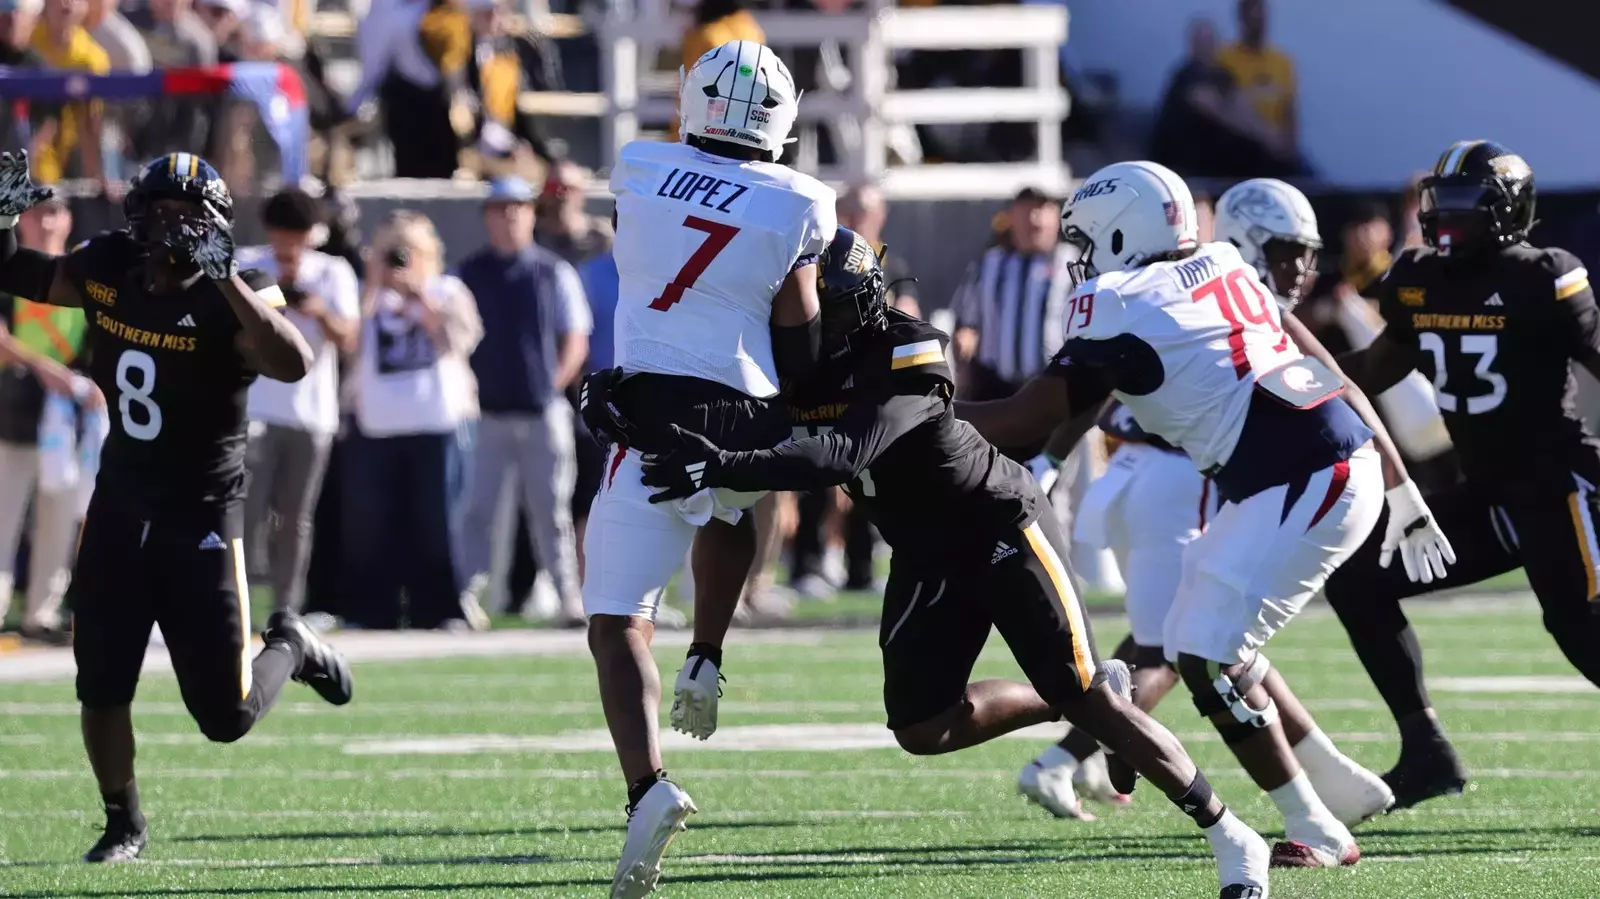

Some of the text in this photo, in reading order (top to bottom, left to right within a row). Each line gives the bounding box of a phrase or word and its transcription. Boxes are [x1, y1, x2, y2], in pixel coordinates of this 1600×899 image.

[750, 110, 771, 124] SBC
[657, 168, 749, 213] LOPEZ
[1069, 178, 1121, 206] JAGS
[646, 215, 742, 312] 7
[96, 311, 198, 351] SOUTHERN MISS
[1066, 294, 1095, 334] 79
[1191, 267, 1288, 381] 79
[1472, 314, 1506, 329] MISS
[1418, 331, 1508, 415] 23
[116, 349, 162, 441] 8
[990, 547, 1018, 565] adidas
